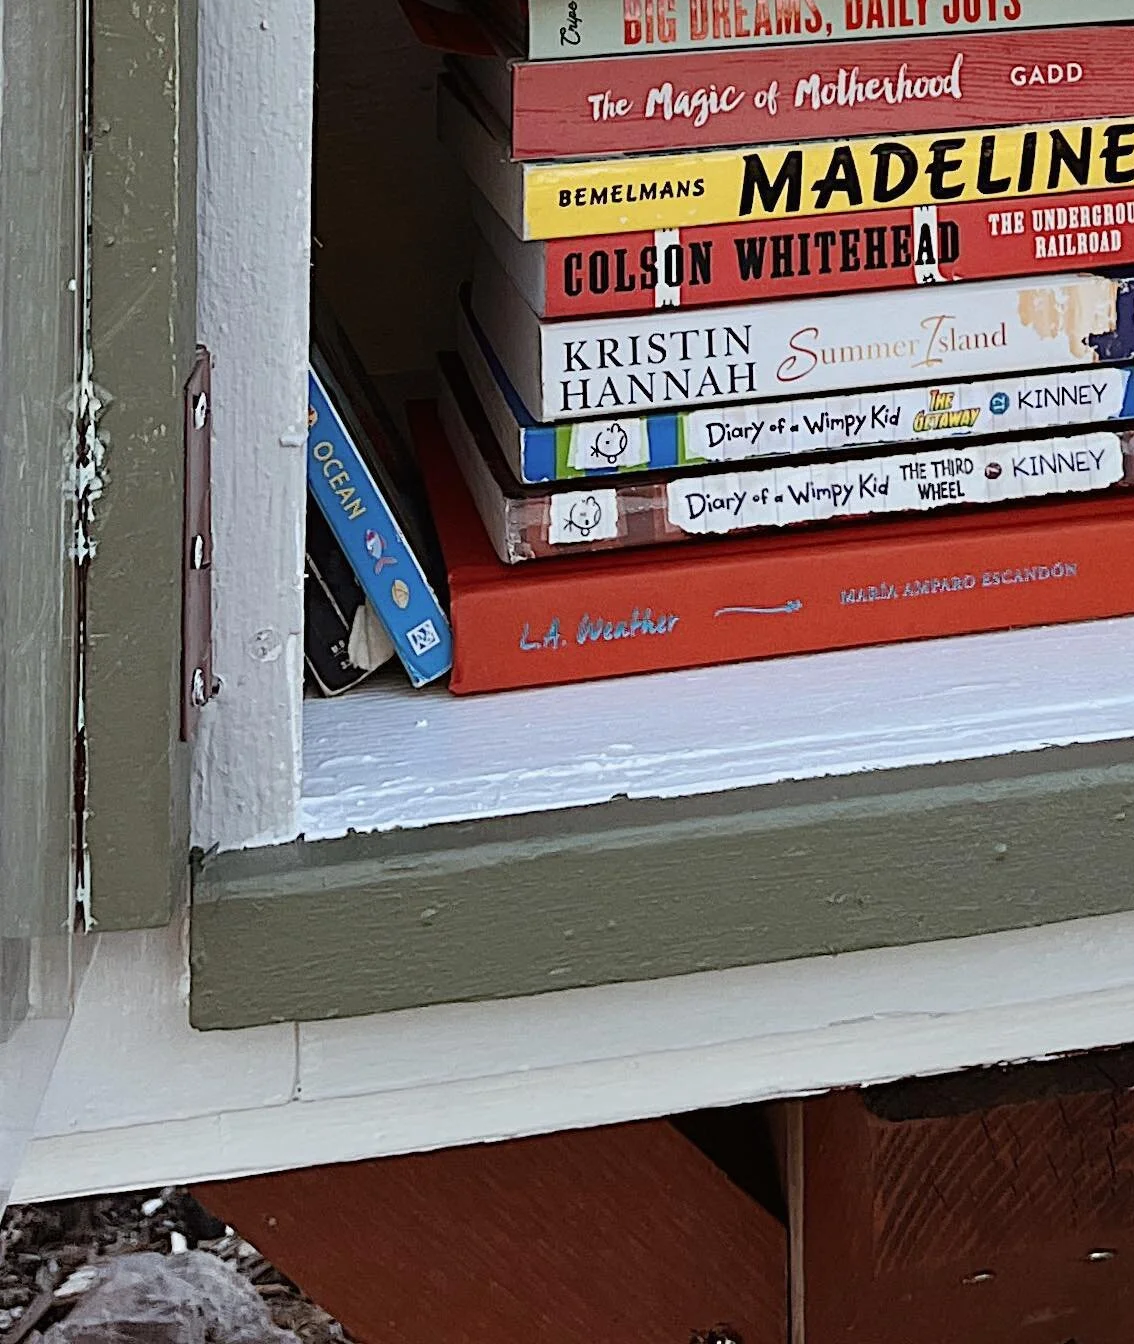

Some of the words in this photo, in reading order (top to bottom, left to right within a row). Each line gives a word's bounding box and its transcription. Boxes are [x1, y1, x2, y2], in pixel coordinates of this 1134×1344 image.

[1010, 62, 1083, 86] GADD
[588, 90, 634, 122] The
[645, 82, 746, 128] Magic
[754, 81, 781, 116] of
[794, 52, 964, 110] Motherhood
[559, 179, 705, 207] BEMELMANS
[988, 210, 1024, 235] THE
[564, 241, 713, 297] COLSON
[735, 220, 960, 281] WHITEHEAD
[1035, 230, 1122, 259] RAILROAD
[563, 324, 752, 372] KRISTIN
[776, 327, 920, 382] Summer
[911, 314, 1008, 368] Island
[560, 362, 757, 411] HANNAH
[928, 389, 954, 412] THE
[1018, 383, 1108, 410] KINNEY
[913, 407, 981, 432] GETAWAY
[900, 462, 928, 480] THE
[931, 458, 974, 478] THIRD
[1012, 449, 1105, 477] KINNEY
[313, 441, 367, 520] OCEAN
[918, 482, 965, 501] WHEEL
[839, 581, 897, 606] MARÍA
[902, 574, 977, 598] AMPARO
[981, 560, 1078, 588] ESCANDÓN
[519, 615, 567, 651] L.A.
[577, 608, 680, 645] Weather
